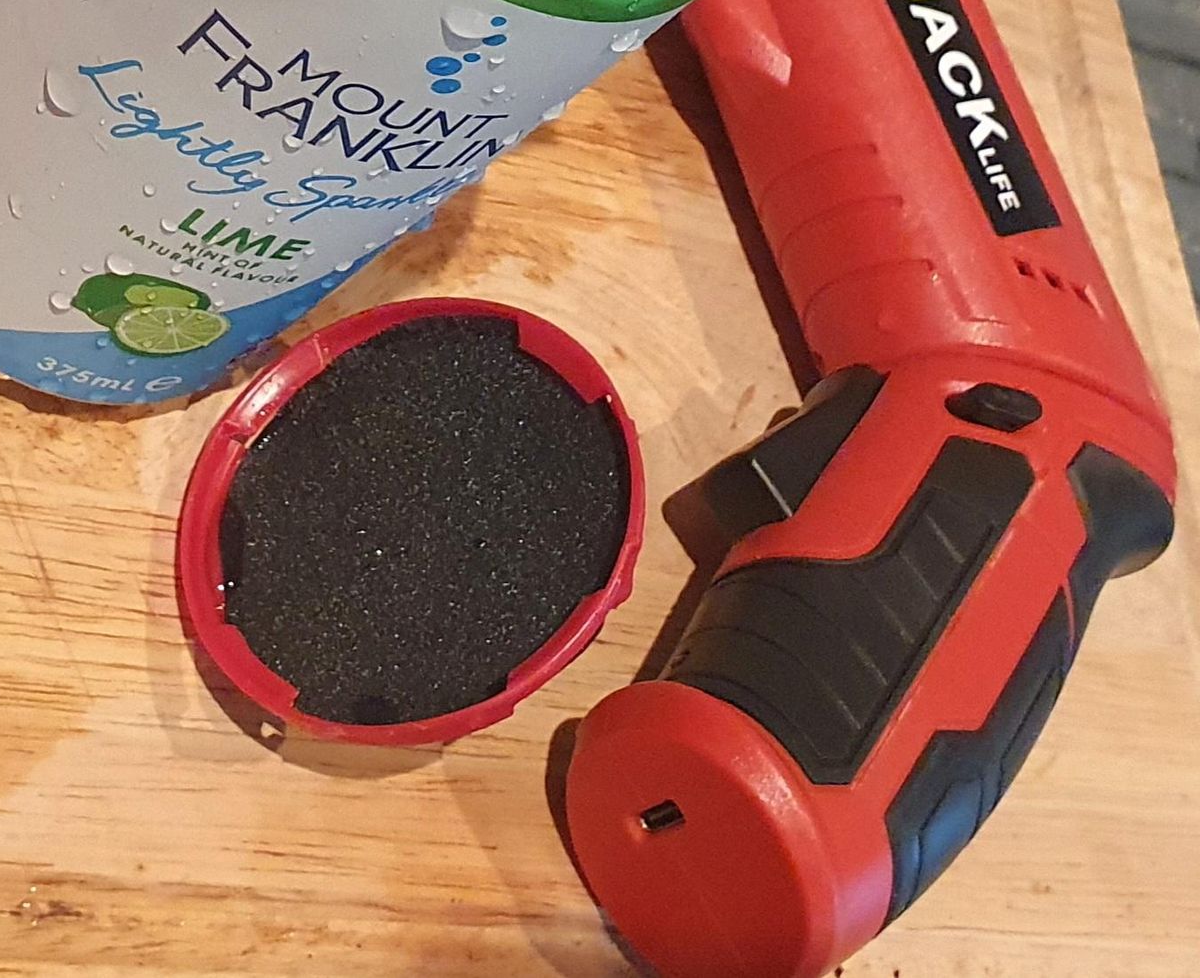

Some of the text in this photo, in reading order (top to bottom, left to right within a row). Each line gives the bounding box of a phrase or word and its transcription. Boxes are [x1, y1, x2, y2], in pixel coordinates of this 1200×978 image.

[78, 58, 268, 196] Lightly
[176, 8, 523, 172] FRANKLIN
[277, 48, 509, 140] MOUNT
[118, 224, 299, 285] NATURAL FLAVOUR
[178, 208, 311, 261] LIME
[181, 241, 264, 270] HINT OF
